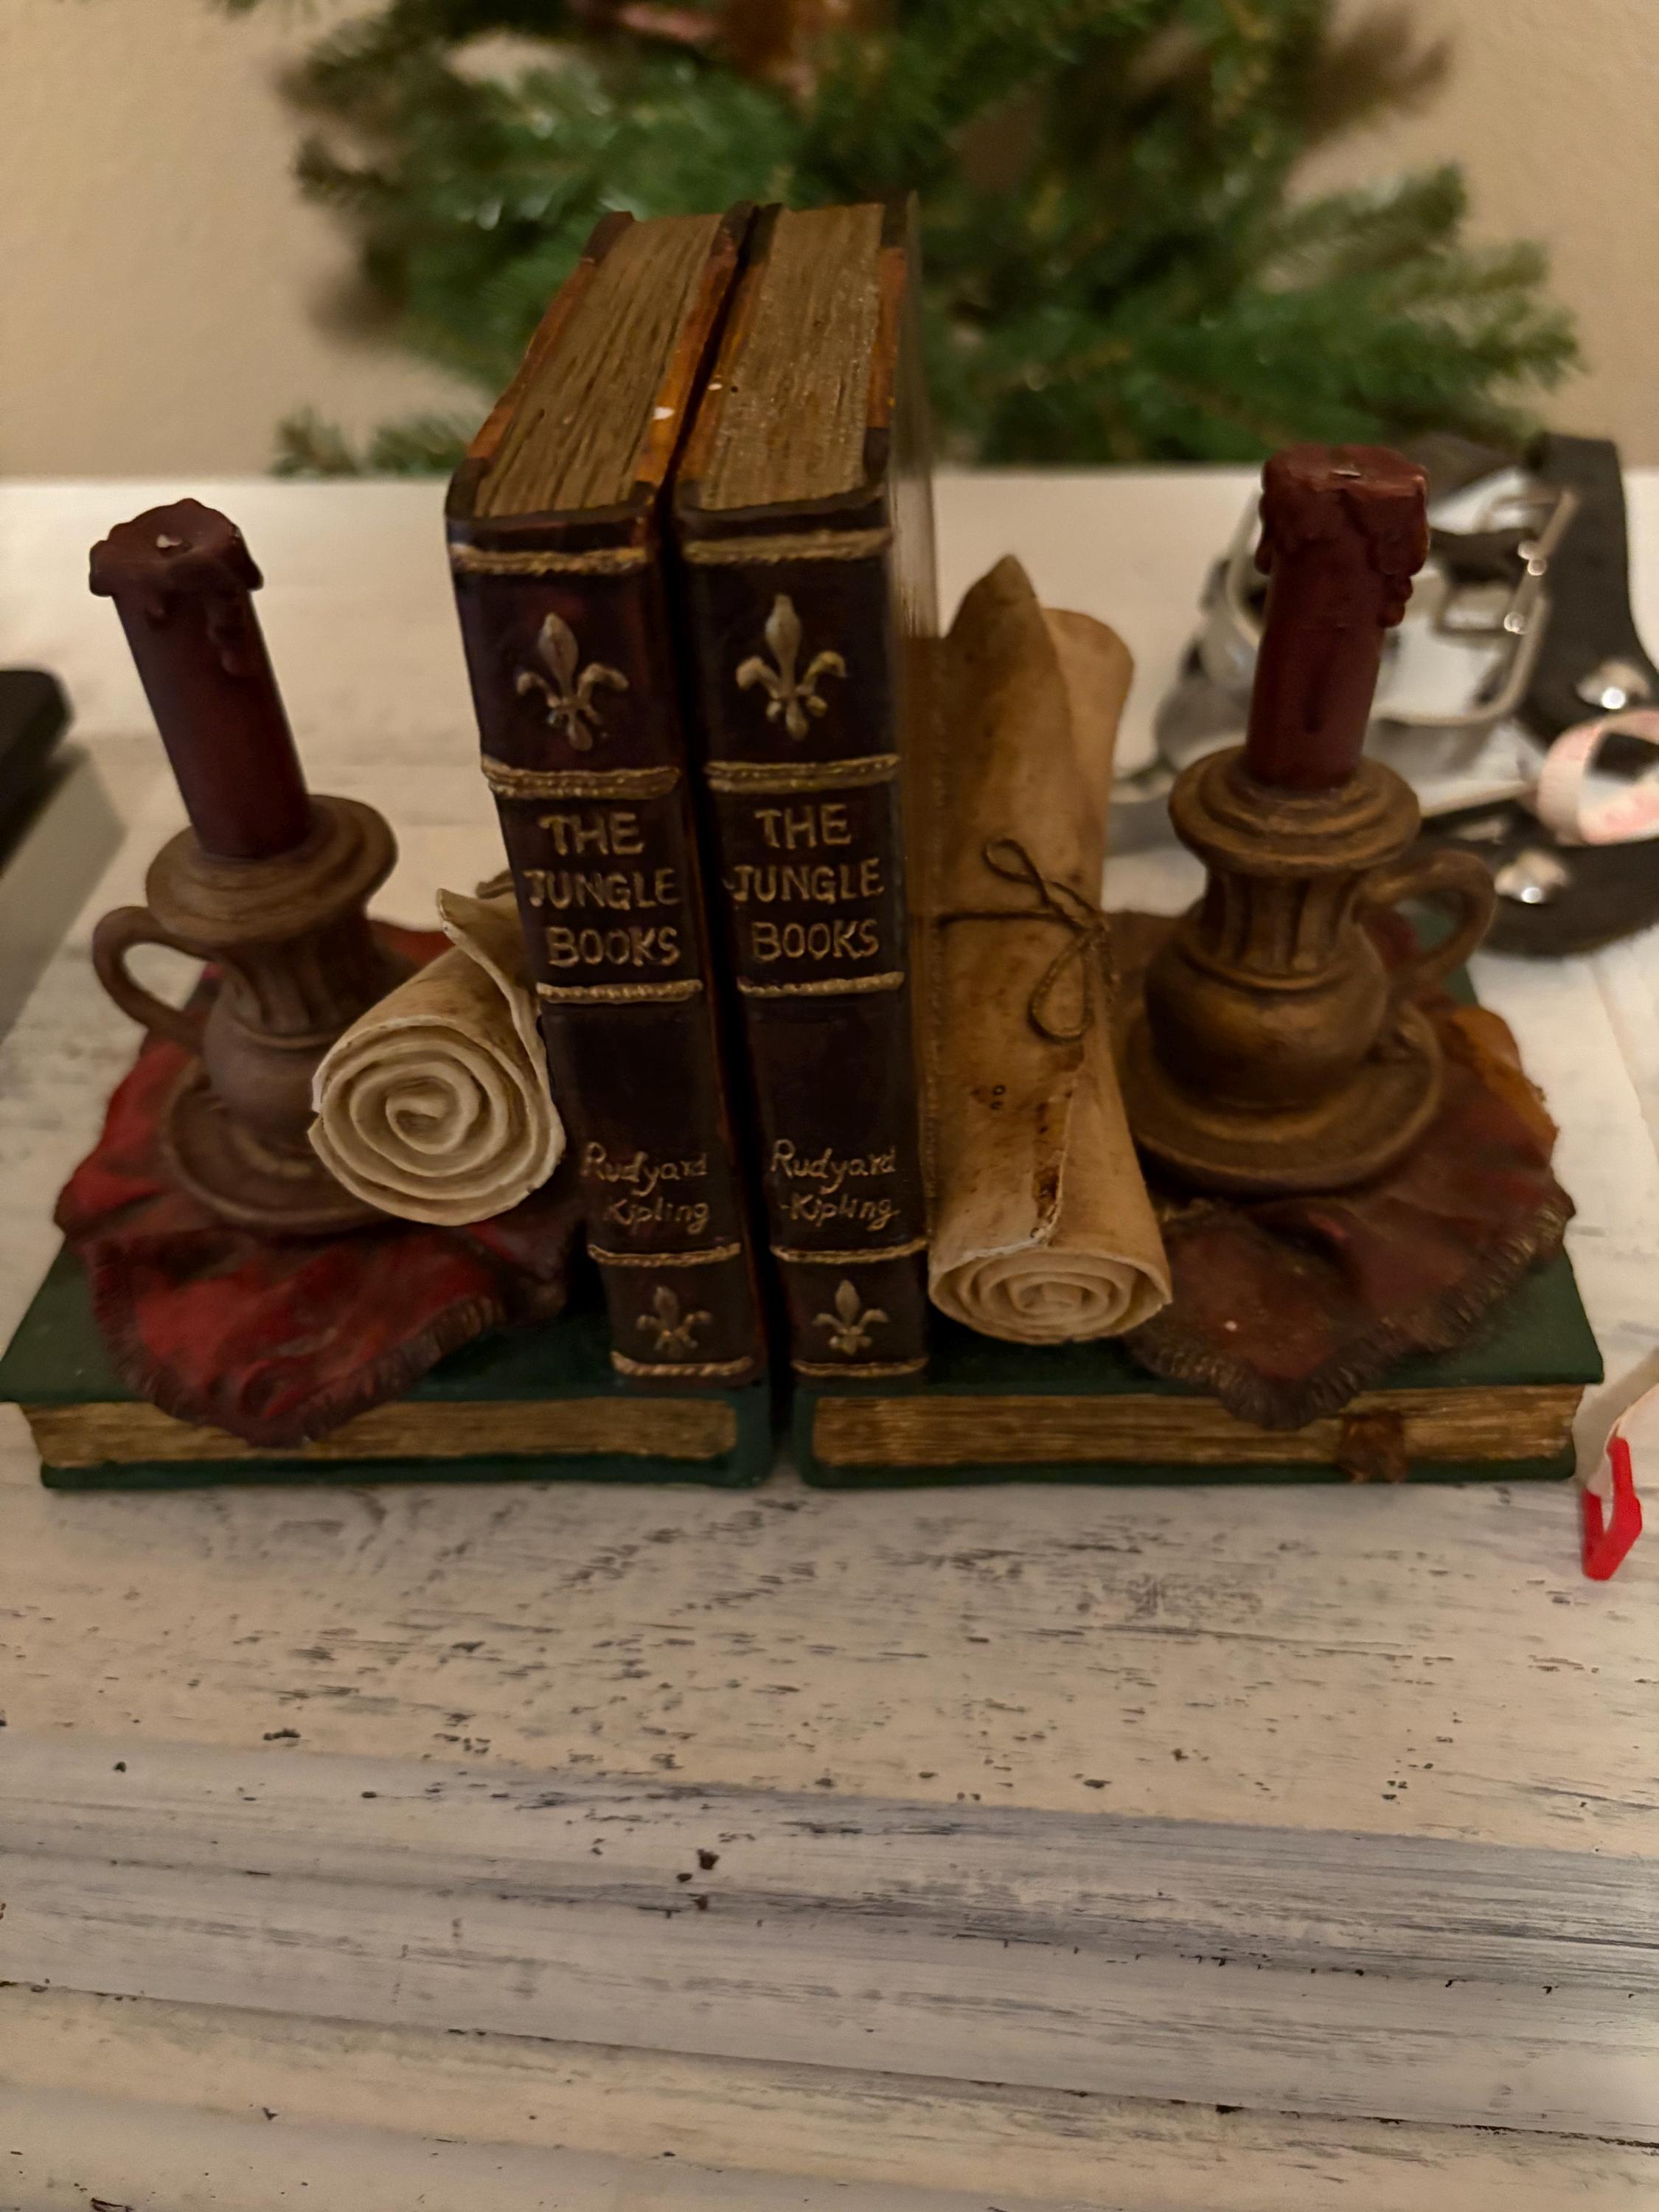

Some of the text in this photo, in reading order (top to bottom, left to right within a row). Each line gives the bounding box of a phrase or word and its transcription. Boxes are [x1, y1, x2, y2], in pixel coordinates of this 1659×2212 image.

[539, 812, 645, 856] THE
[754, 803, 852, 849] THE
[523, 868, 681, 911] JUNGLE
[724, 858, 885, 905] JUNGLE
[546, 926, 681, 967] BOOKS
[752, 919, 880, 962] BOOKS
[581, 1141, 709, 1197] Rudyard
[770, 1138, 897, 1195] Rudyard
[604, 1196, 709, 1235] Kipling
